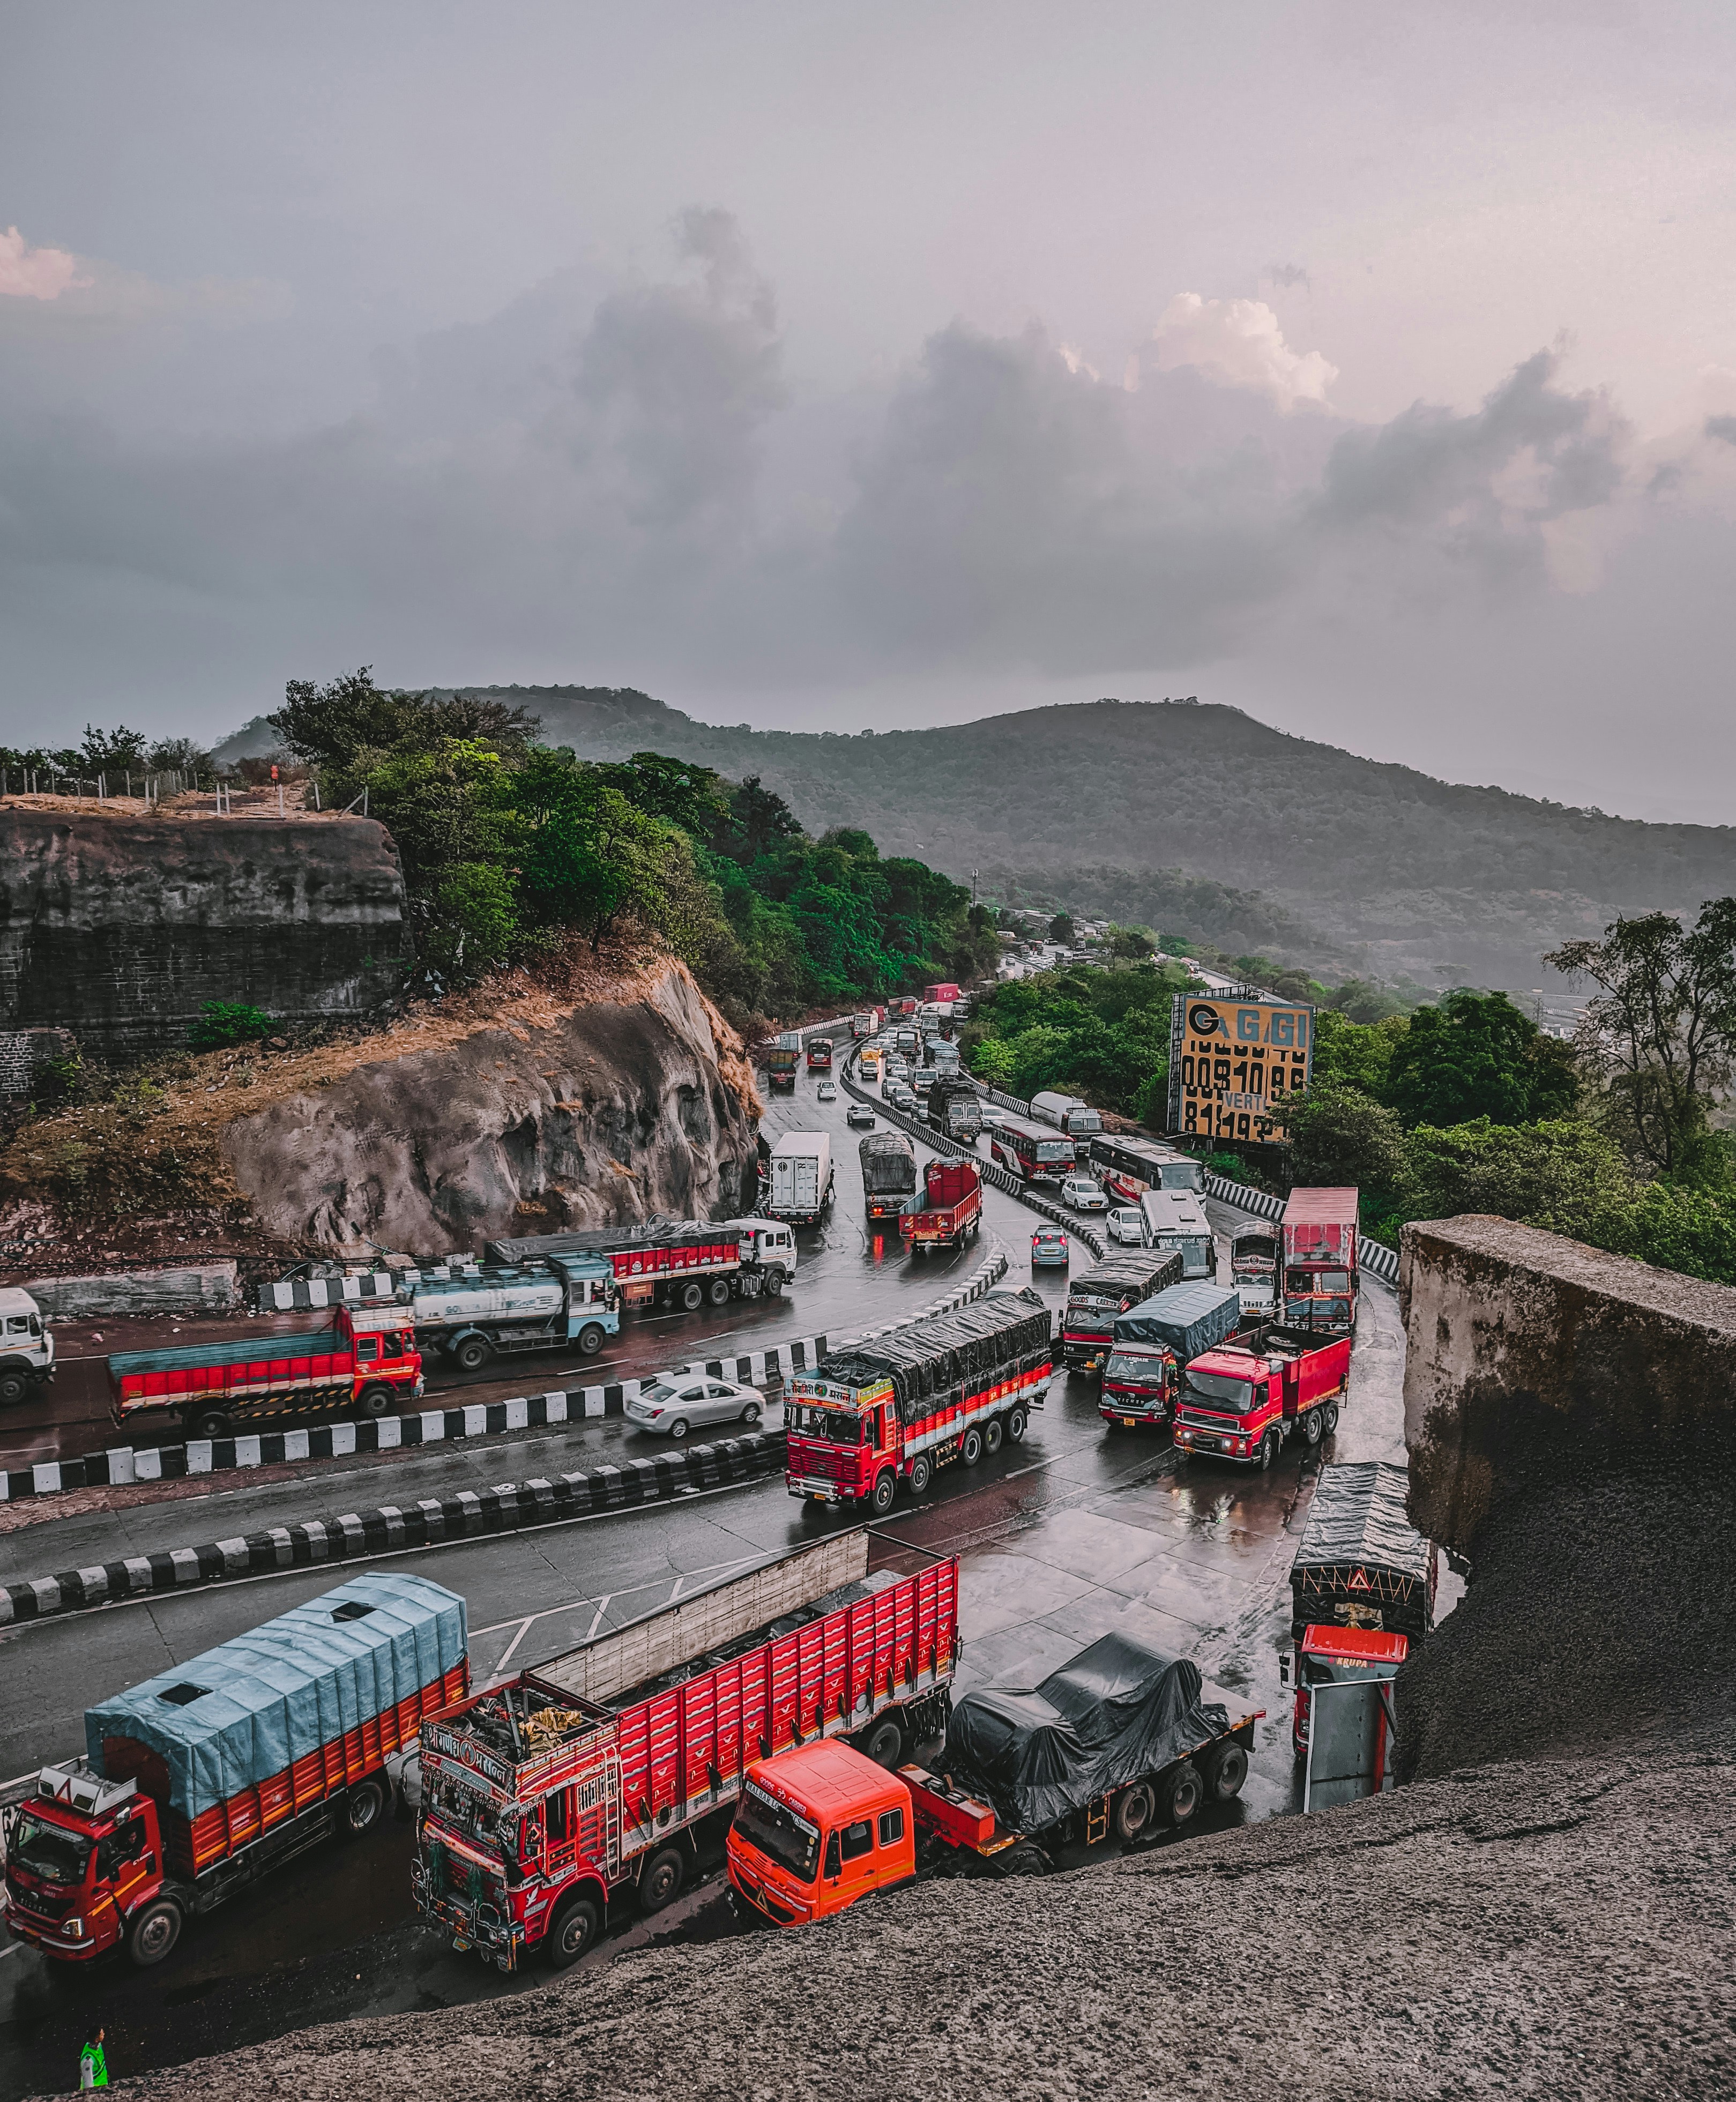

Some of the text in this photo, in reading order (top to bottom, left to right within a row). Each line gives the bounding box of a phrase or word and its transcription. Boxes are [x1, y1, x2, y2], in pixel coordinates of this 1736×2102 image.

[829, 1390, 851, 1402] प्रसन्न
[1336, 1657, 1368, 1668] KRUPA
[475, 1749, 507, 1785] प्रसन्न
[747, 1782, 771, 1804] MALHAR
[759, 1776, 775, 1792] GOODS
[788, 1797, 807, 1815] CARRIER
